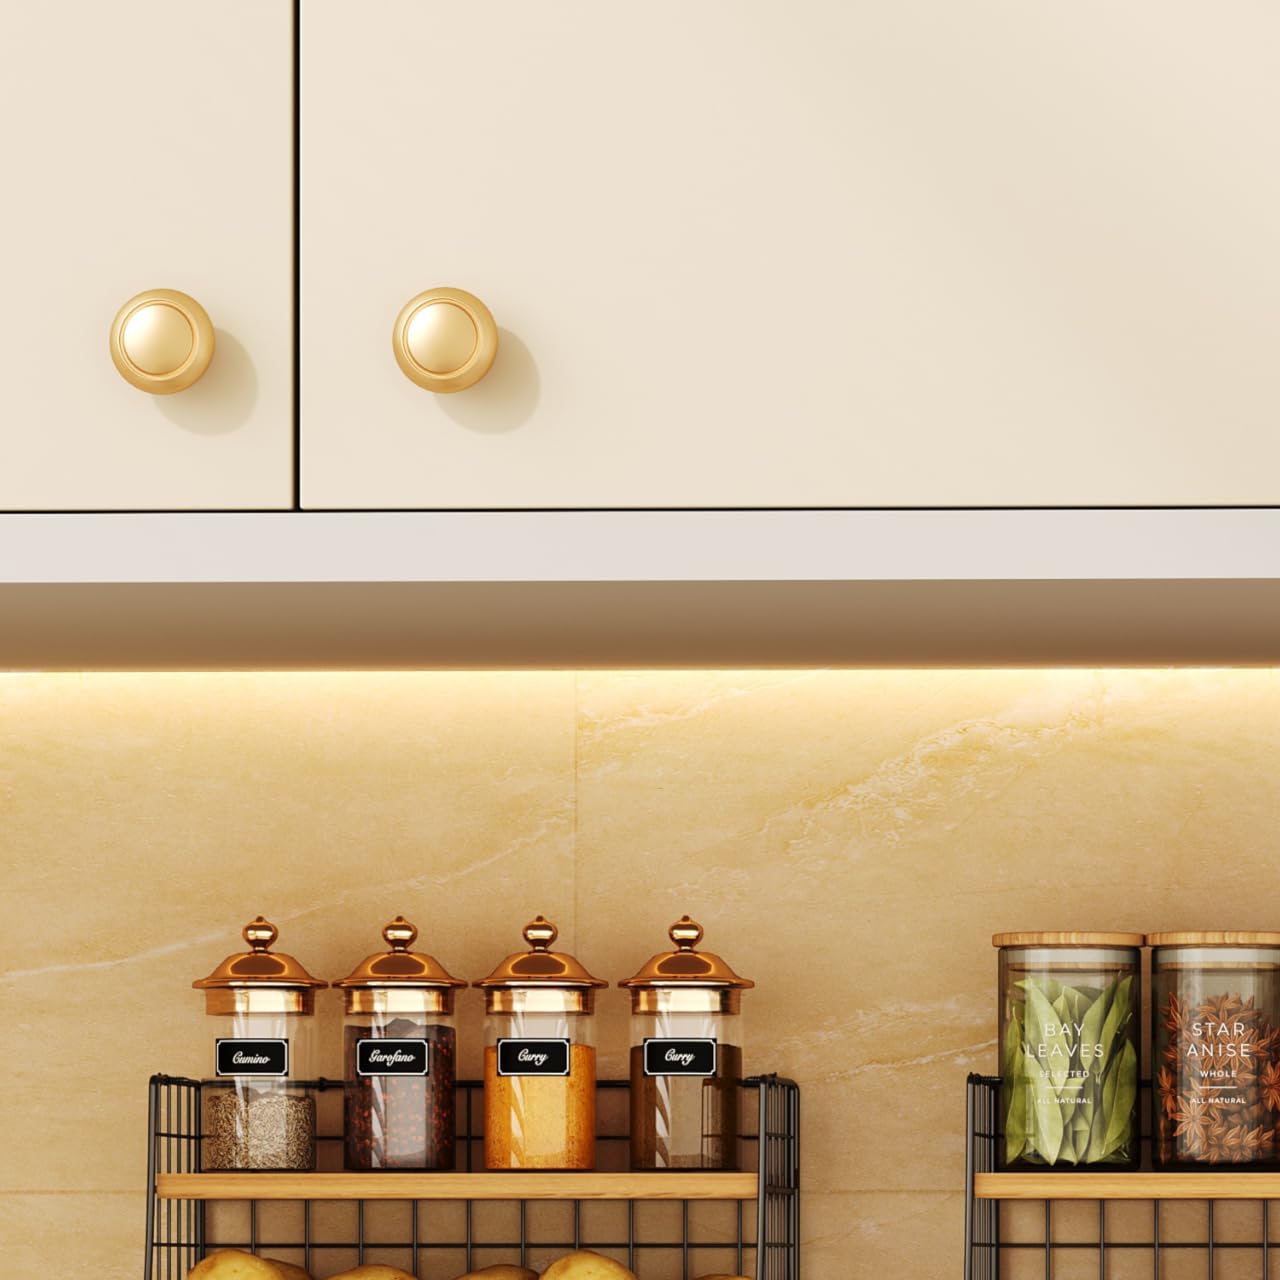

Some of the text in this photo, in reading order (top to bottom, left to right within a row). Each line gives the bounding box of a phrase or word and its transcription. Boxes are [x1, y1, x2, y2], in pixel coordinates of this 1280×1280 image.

[1045, 1023, 1084, 1037] BAY
[1192, 1022, 1245, 1037] STAR
[516, 1048, 549, 1066] Curry
[663, 1048, 695, 1066] Curry
[1026, 1043, 1104, 1058] LEAVES
[1186, 1043, 1251, 1057] ANISE
[367, 1049, 416, 1067] Garofano
[1039, 1070, 1090, 1078] SELECTED
[1200, 1070, 1237, 1078] WHOLE
